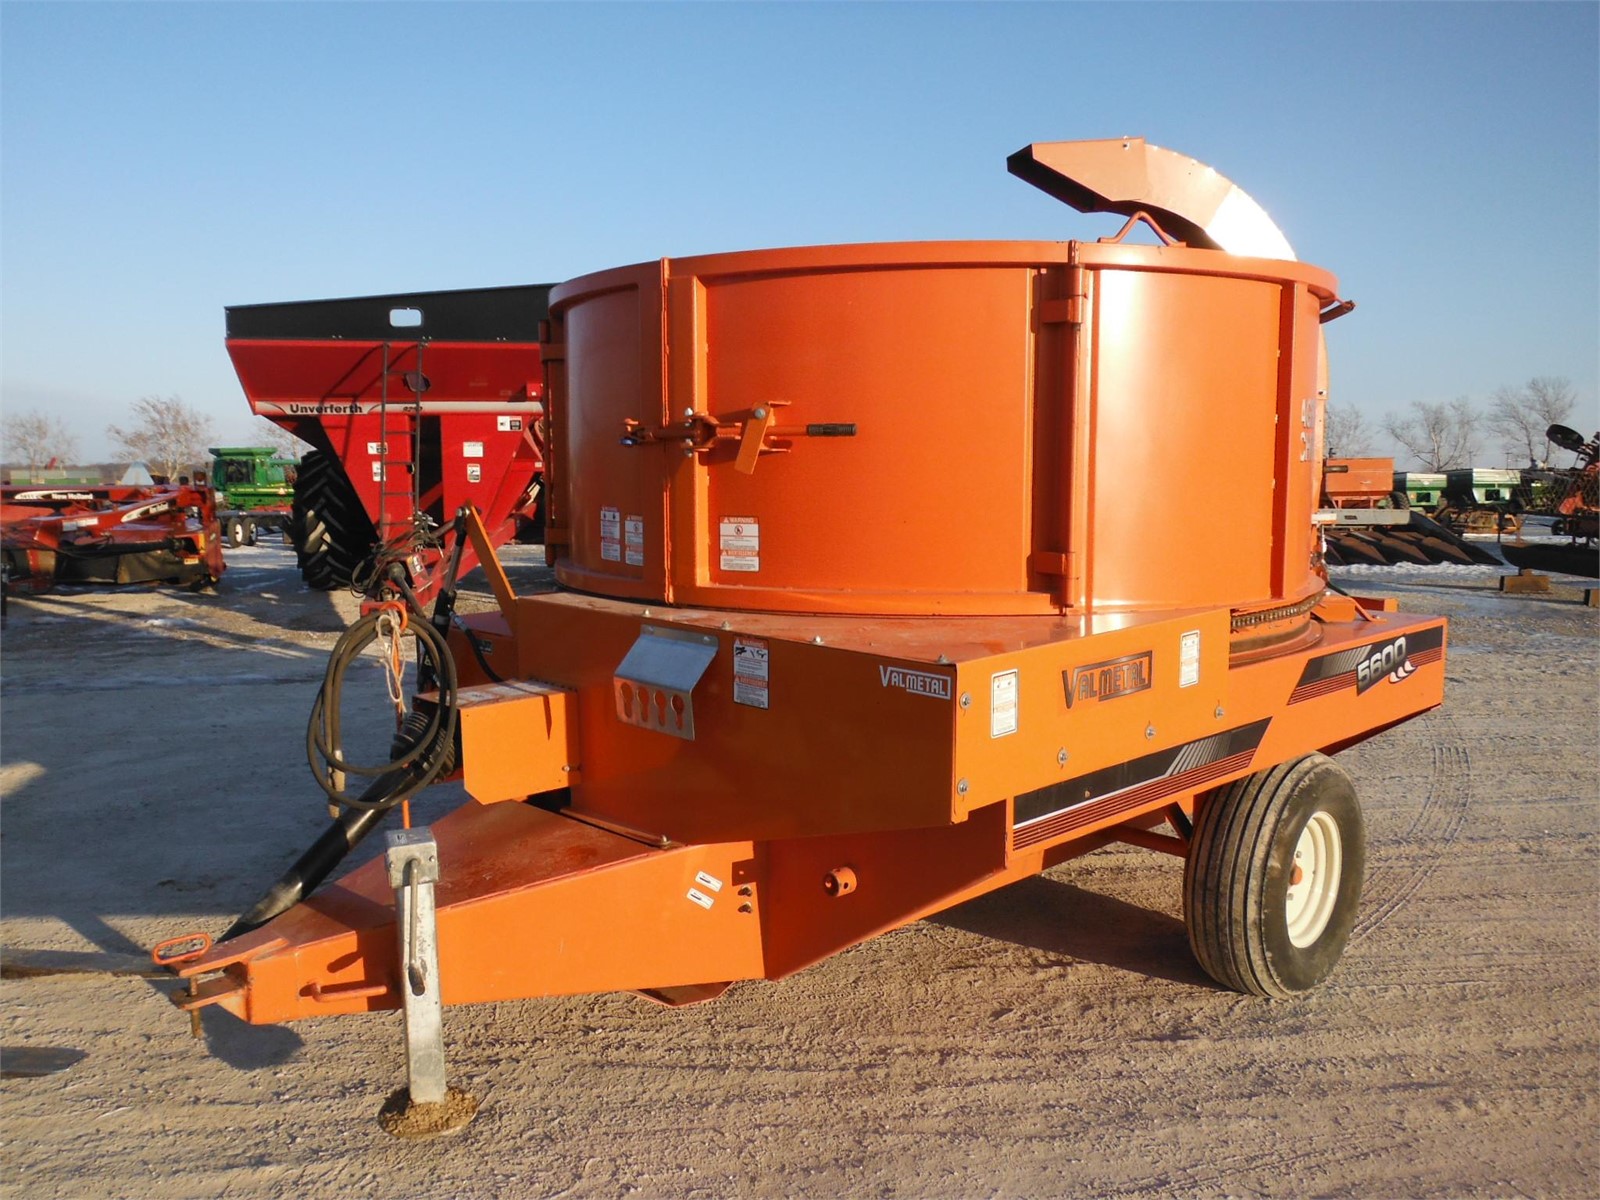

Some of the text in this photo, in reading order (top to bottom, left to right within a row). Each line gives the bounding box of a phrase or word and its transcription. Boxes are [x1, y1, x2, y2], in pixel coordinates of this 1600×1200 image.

[290, 404, 362, 413] Unverferth
[879, 664, 951, 700] VALMETAL
[1061, 650, 1152, 709] VALMETAL
[1357, 636, 1406, 691] 5600
